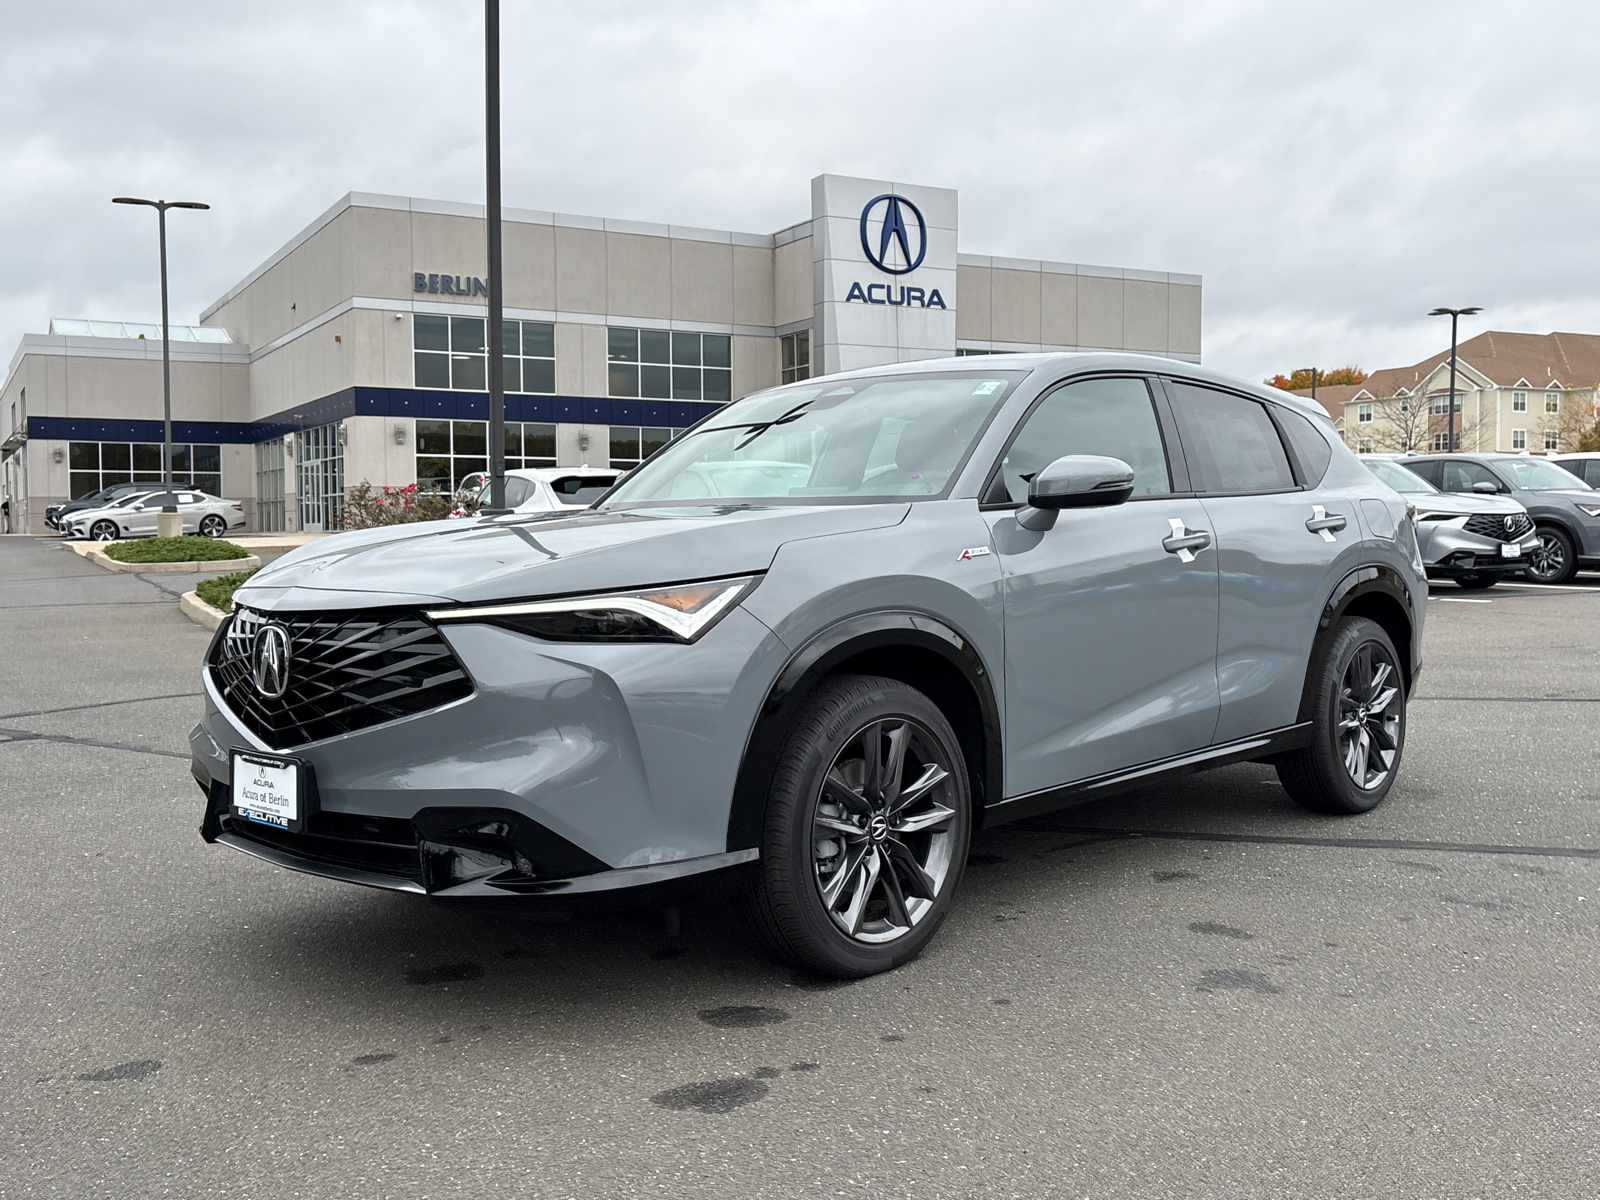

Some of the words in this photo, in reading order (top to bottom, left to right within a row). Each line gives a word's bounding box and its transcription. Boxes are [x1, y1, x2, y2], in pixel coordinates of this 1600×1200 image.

[414, 272, 489, 298] BERLIN
[845, 281, 947, 309] ACURA
[252, 778, 275, 789] ACURA
[241, 786, 259, 802] Acura
[259, 792, 267, 803] of
[268, 792, 290, 808] Berlin
[238, 807, 288, 827] EXECUTIVE
